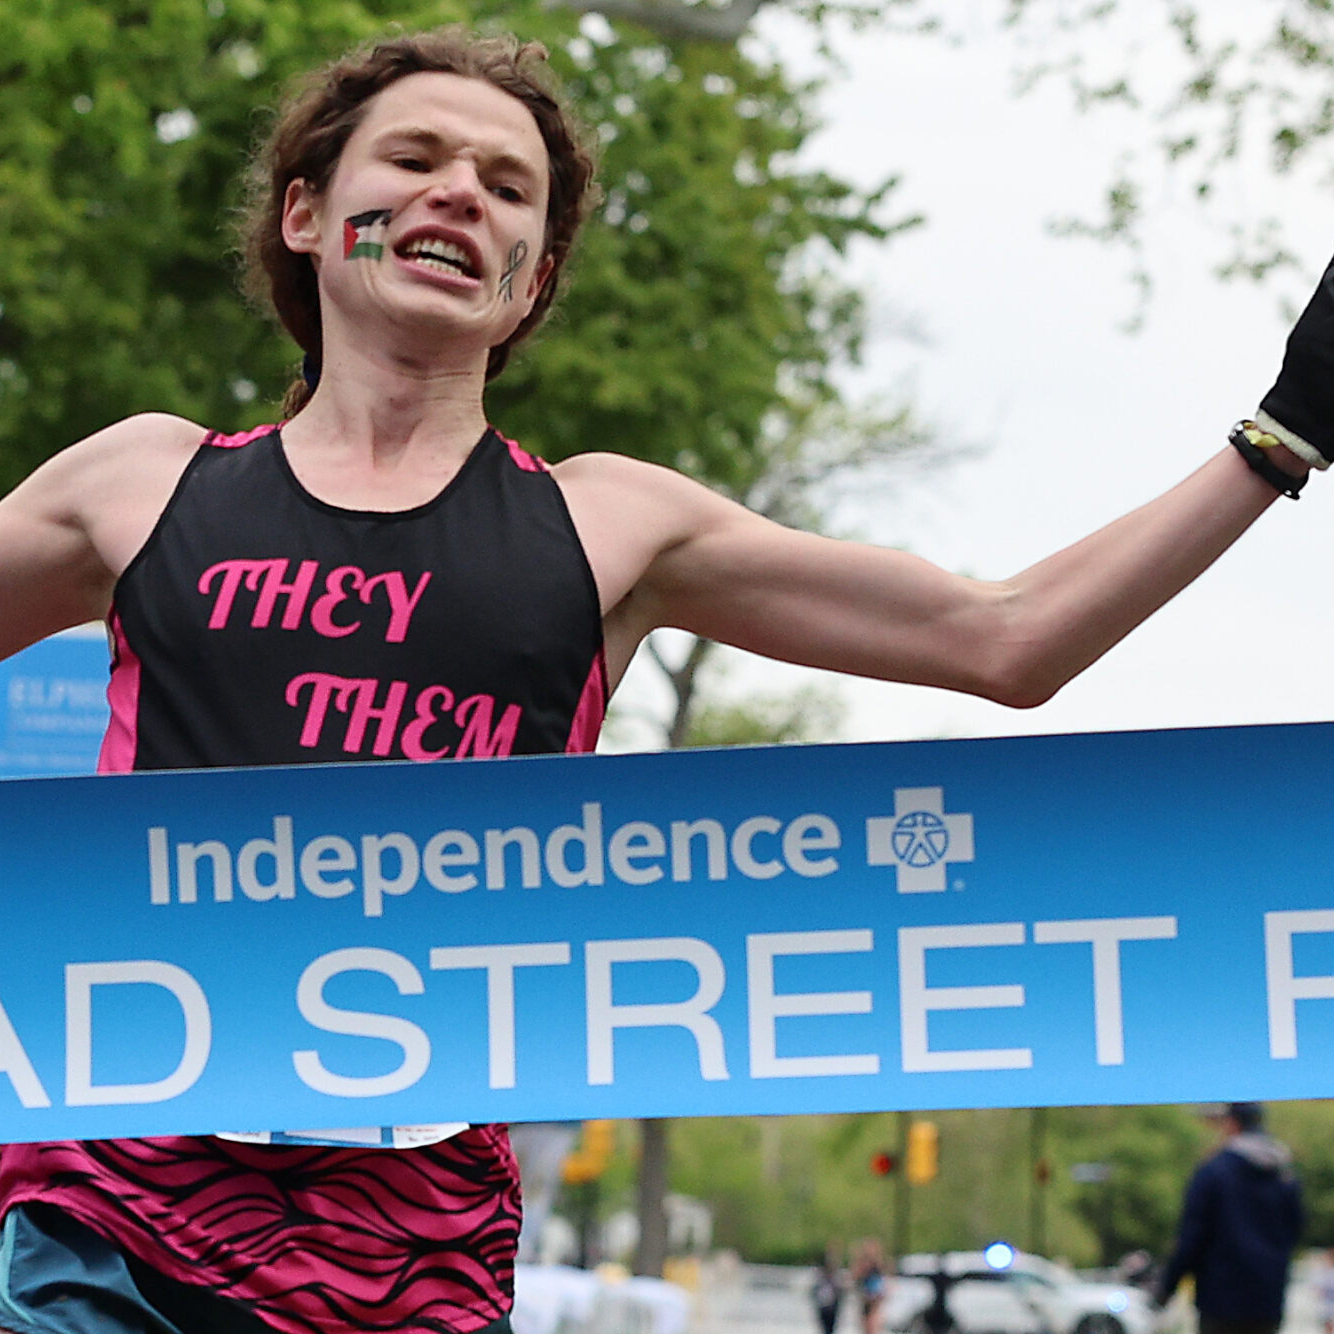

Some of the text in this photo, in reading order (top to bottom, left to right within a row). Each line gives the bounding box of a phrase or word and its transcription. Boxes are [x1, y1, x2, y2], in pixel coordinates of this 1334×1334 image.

[197, 557, 433, 644] THEY
[285, 672, 523, 763] THEM
[148, 802, 842, 918] Independence
[291, 914, 1178, 1100] STREET
